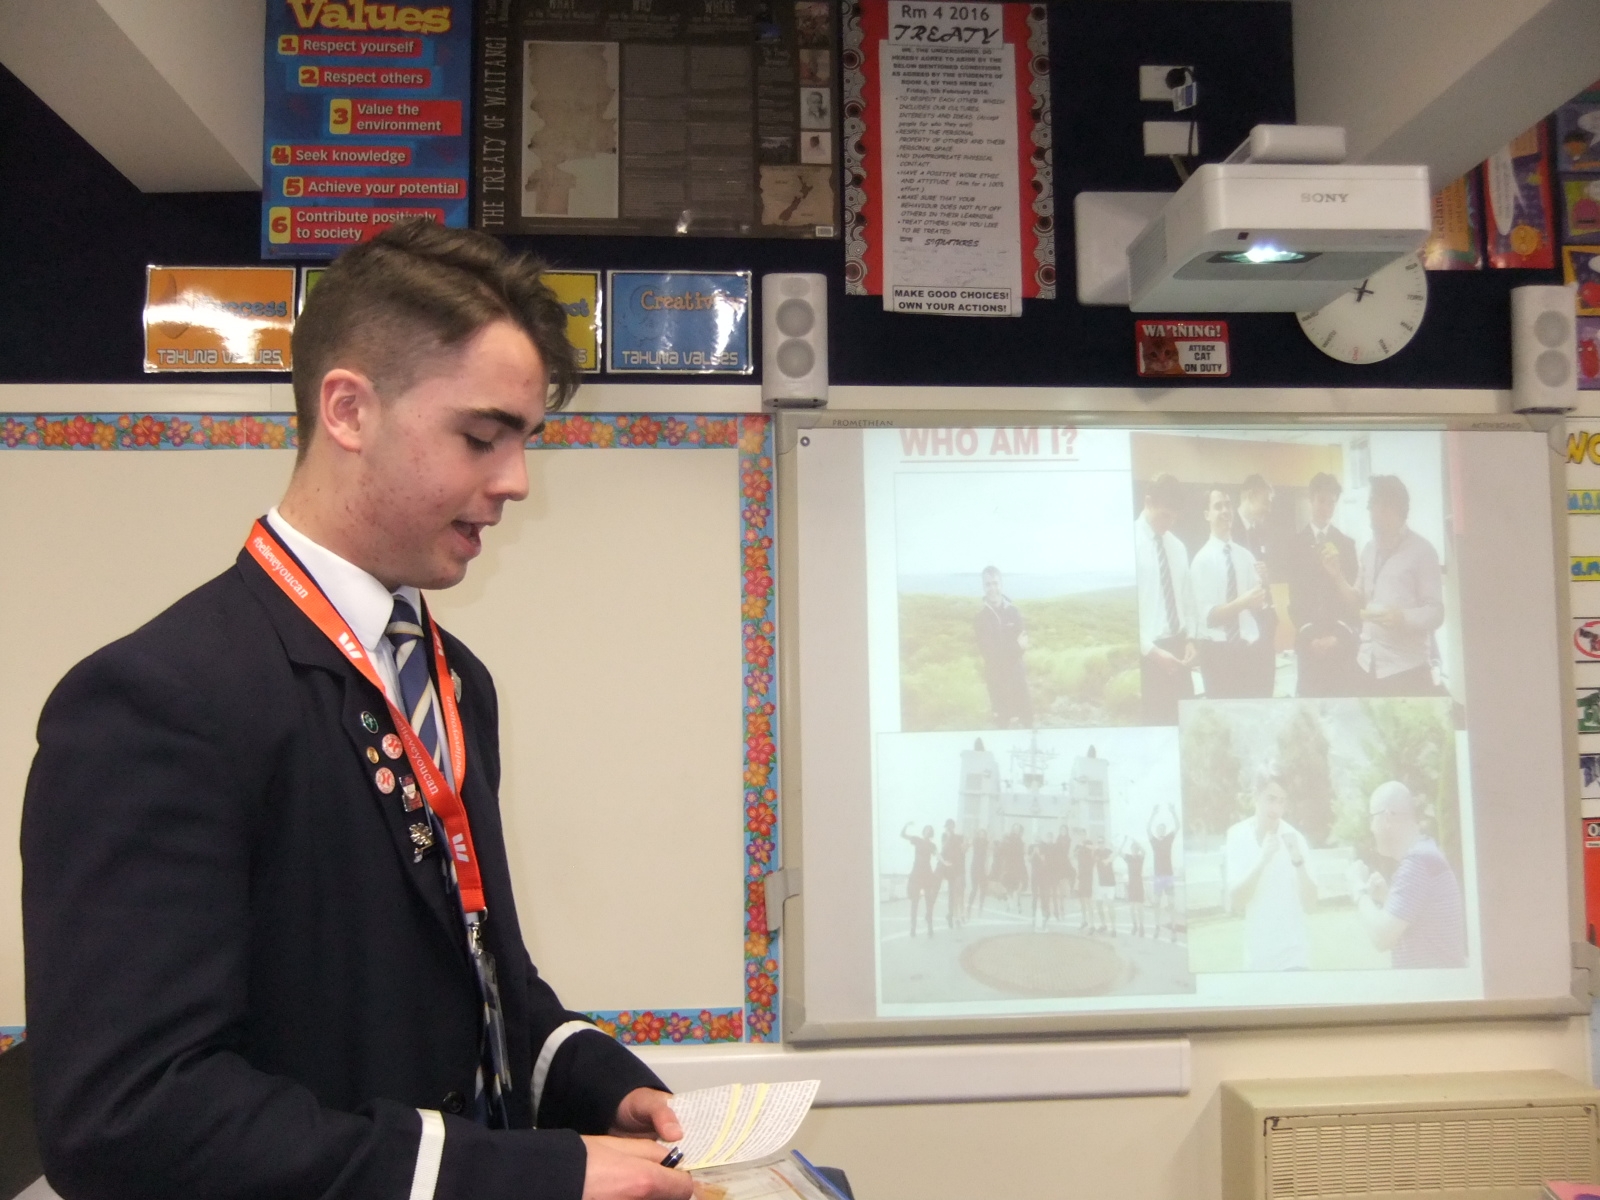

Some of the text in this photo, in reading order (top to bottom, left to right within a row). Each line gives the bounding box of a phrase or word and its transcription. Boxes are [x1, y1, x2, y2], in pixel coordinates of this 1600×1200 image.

[288, 0, 452, 34] Values
[902, 5, 990, 21] Rm 4 2016
[894, 25, 999, 44] TREATY
[281, 38, 414, 53] 1 Respect yourself
[301, 70, 423, 84] 2 Respect others
[484, 36, 507, 107] WAITANGI
[332, 104, 419, 124] 3 Value the
[483, 115, 505, 129] OF
[356, 119, 442, 131] environment
[272, 147, 406, 164] 4 Seek knowledge
[482, 136, 507, 193] TREATY
[285, 179, 459, 196] 5 Achieve your potential
[1301, 192, 1349, 202] SONY
[272, 217, 288, 232] 6
[297, 211, 368, 222] Contribute
[482, 201, 505, 228] THE
[296, 228, 362, 241] to society
[895, 290, 1009, 299] MAKE GOOD CHOICES!
[898, 302, 1007, 312] OWN YOUR ACTIONS!
[1142, 324, 1221, 337] WARNING!
[1184, 364, 1222, 372] ON DUTY
[832, 419, 894, 427] PROMETHEAN
[900, 424, 1078, 456] WHO AM I?
[253, 535, 309, 600] #believeyoucan
